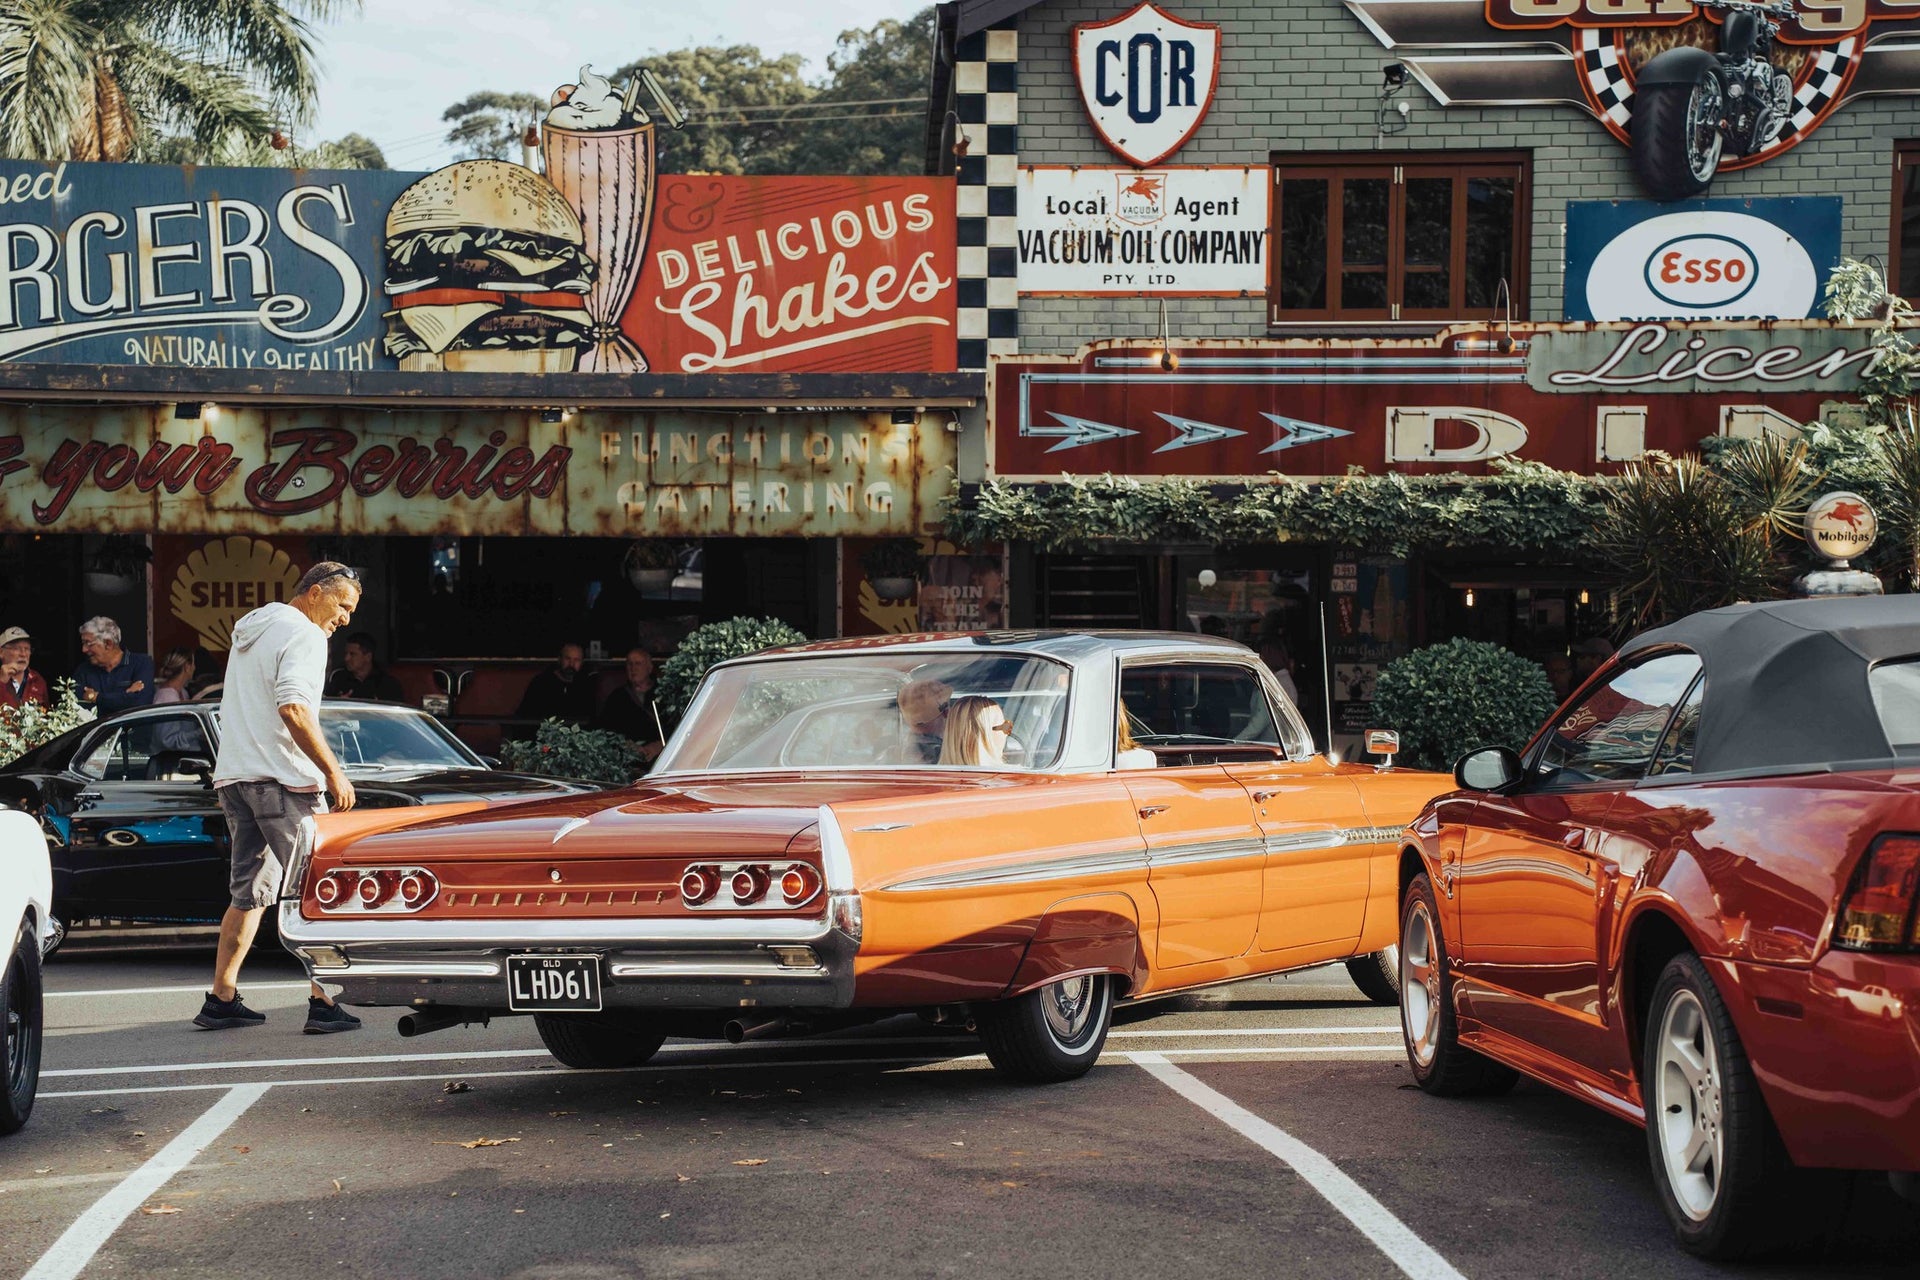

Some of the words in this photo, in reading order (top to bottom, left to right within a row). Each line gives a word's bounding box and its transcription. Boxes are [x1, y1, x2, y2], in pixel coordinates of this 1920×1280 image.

[1095, 33, 1198, 124] COR
[662, 182, 725, 234] &
[1046, 196, 1106, 215] Local
[1174, 197, 1240, 222] Agent
[1122, 206, 1159, 214] VACUUM
[656, 193, 934, 290] DELICIOUS
[1017, 230, 1113, 264] VACUUM
[1121, 230, 1155, 264] OIL
[1161, 230, 1266, 264] COMPANY
[655, 251, 952, 373] Shakes
[124, 335, 257, 368] NATURALLY
[264, 338, 376, 371] HEALTHY
[1549, 324, 1920, 385] Licen
[600, 431, 911, 464] FUNCTIONS
[32, 434, 243, 525] your
[244, 426, 574, 517] Berries
[616, 481, 895, 514] CATERING
[1817, 530, 1871, 546] Mobilgas
[191, 581, 285, 608] SHELL
[937, 585, 984, 598] JOIN
[943, 603, 980, 617] THE
[447, 890, 664, 907] BONNEVILLE
[542, 959, 562, 968] QLD
